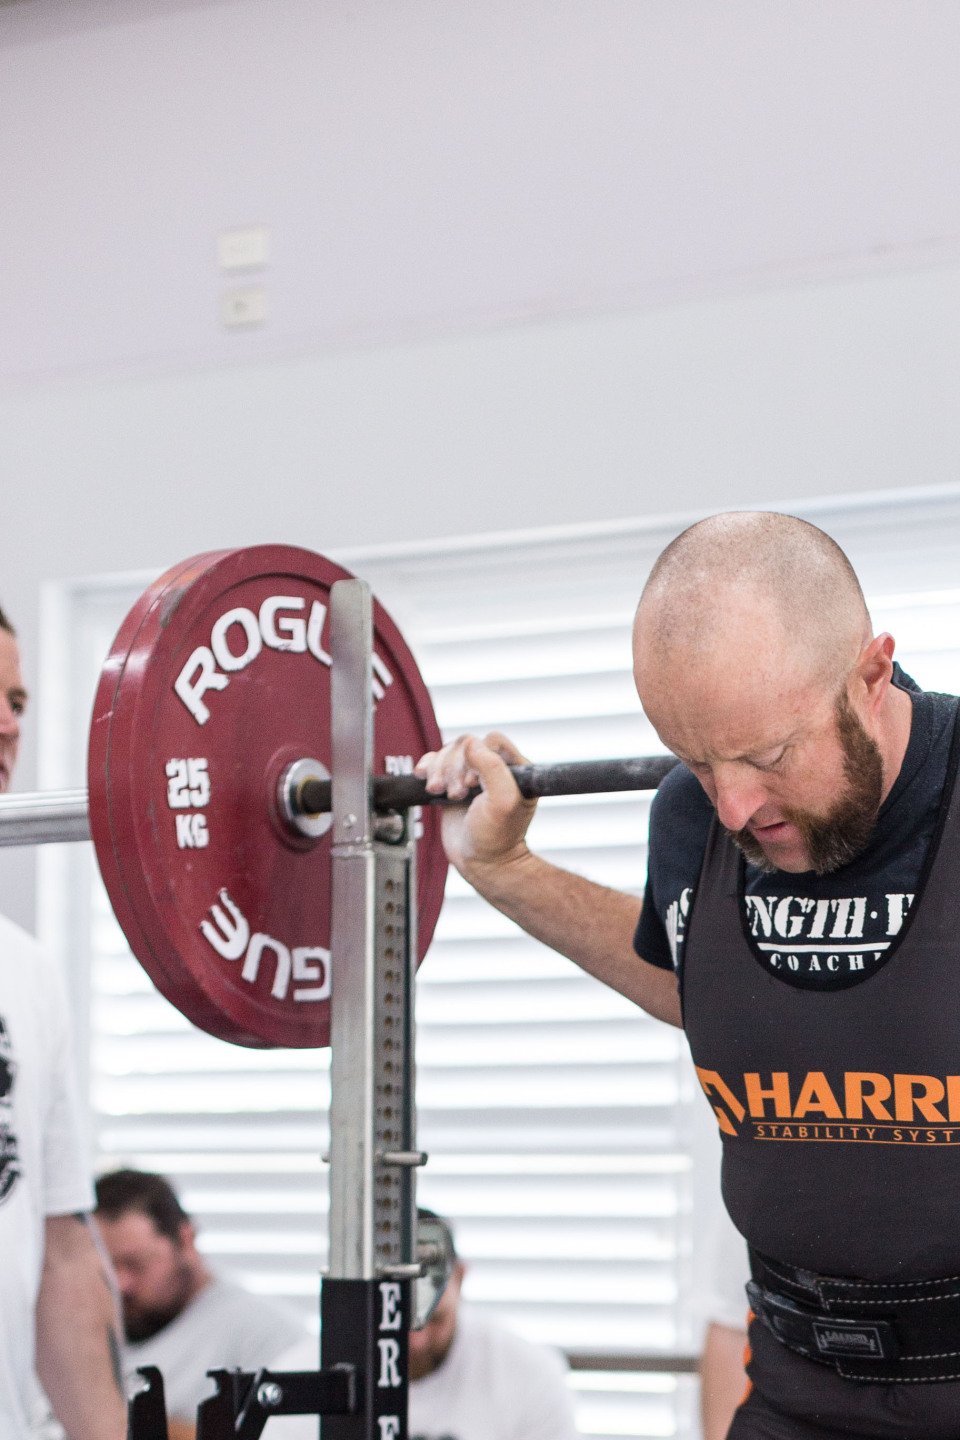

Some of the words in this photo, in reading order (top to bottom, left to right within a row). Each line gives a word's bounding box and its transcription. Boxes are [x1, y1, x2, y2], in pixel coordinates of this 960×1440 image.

[166, 757, 211, 809] 25
[175, 814, 209, 849] KG
[200, 888, 331, 1001] GUE
[756, 1123, 876, 1142] STABILITY
[377, 1281, 401, 1389] ER
